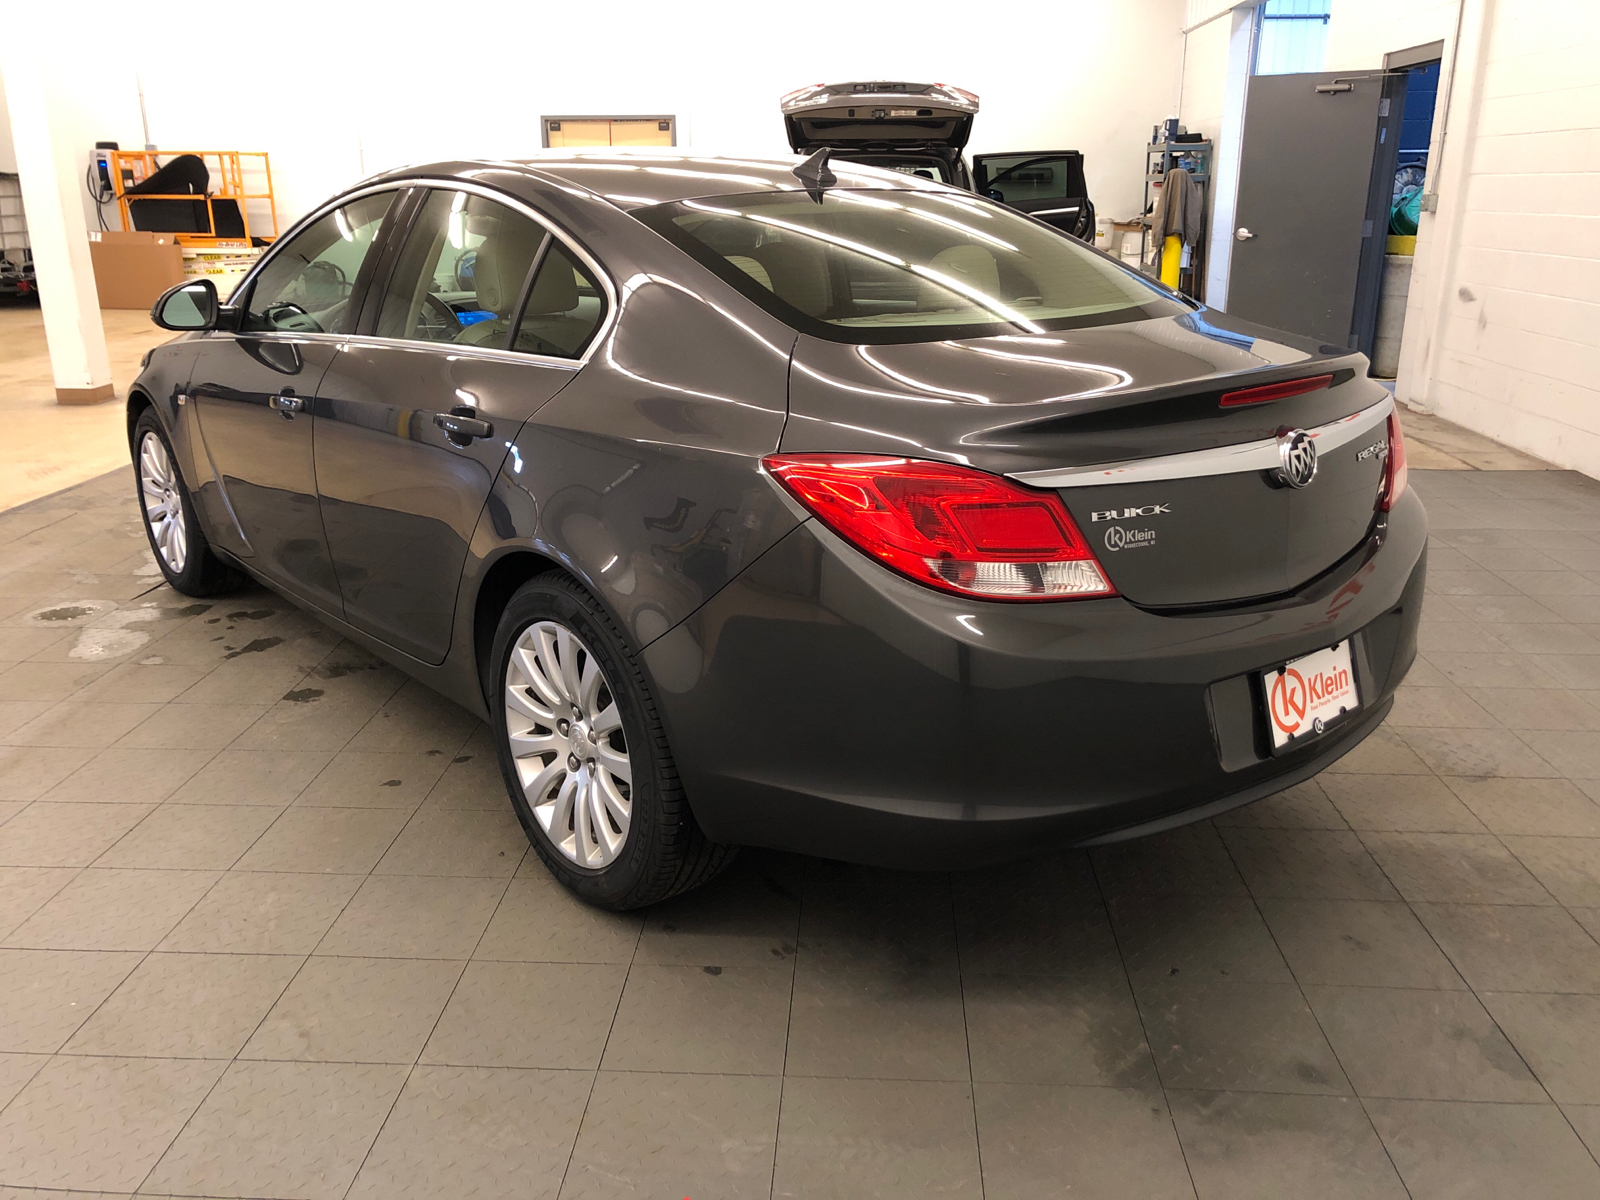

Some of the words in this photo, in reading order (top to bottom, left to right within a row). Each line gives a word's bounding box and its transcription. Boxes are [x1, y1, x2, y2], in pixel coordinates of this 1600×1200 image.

[1091, 503, 1171, 522] BUICK
[1127, 529, 1155, 542] Klein
[1308, 665, 1349, 704] Klein
